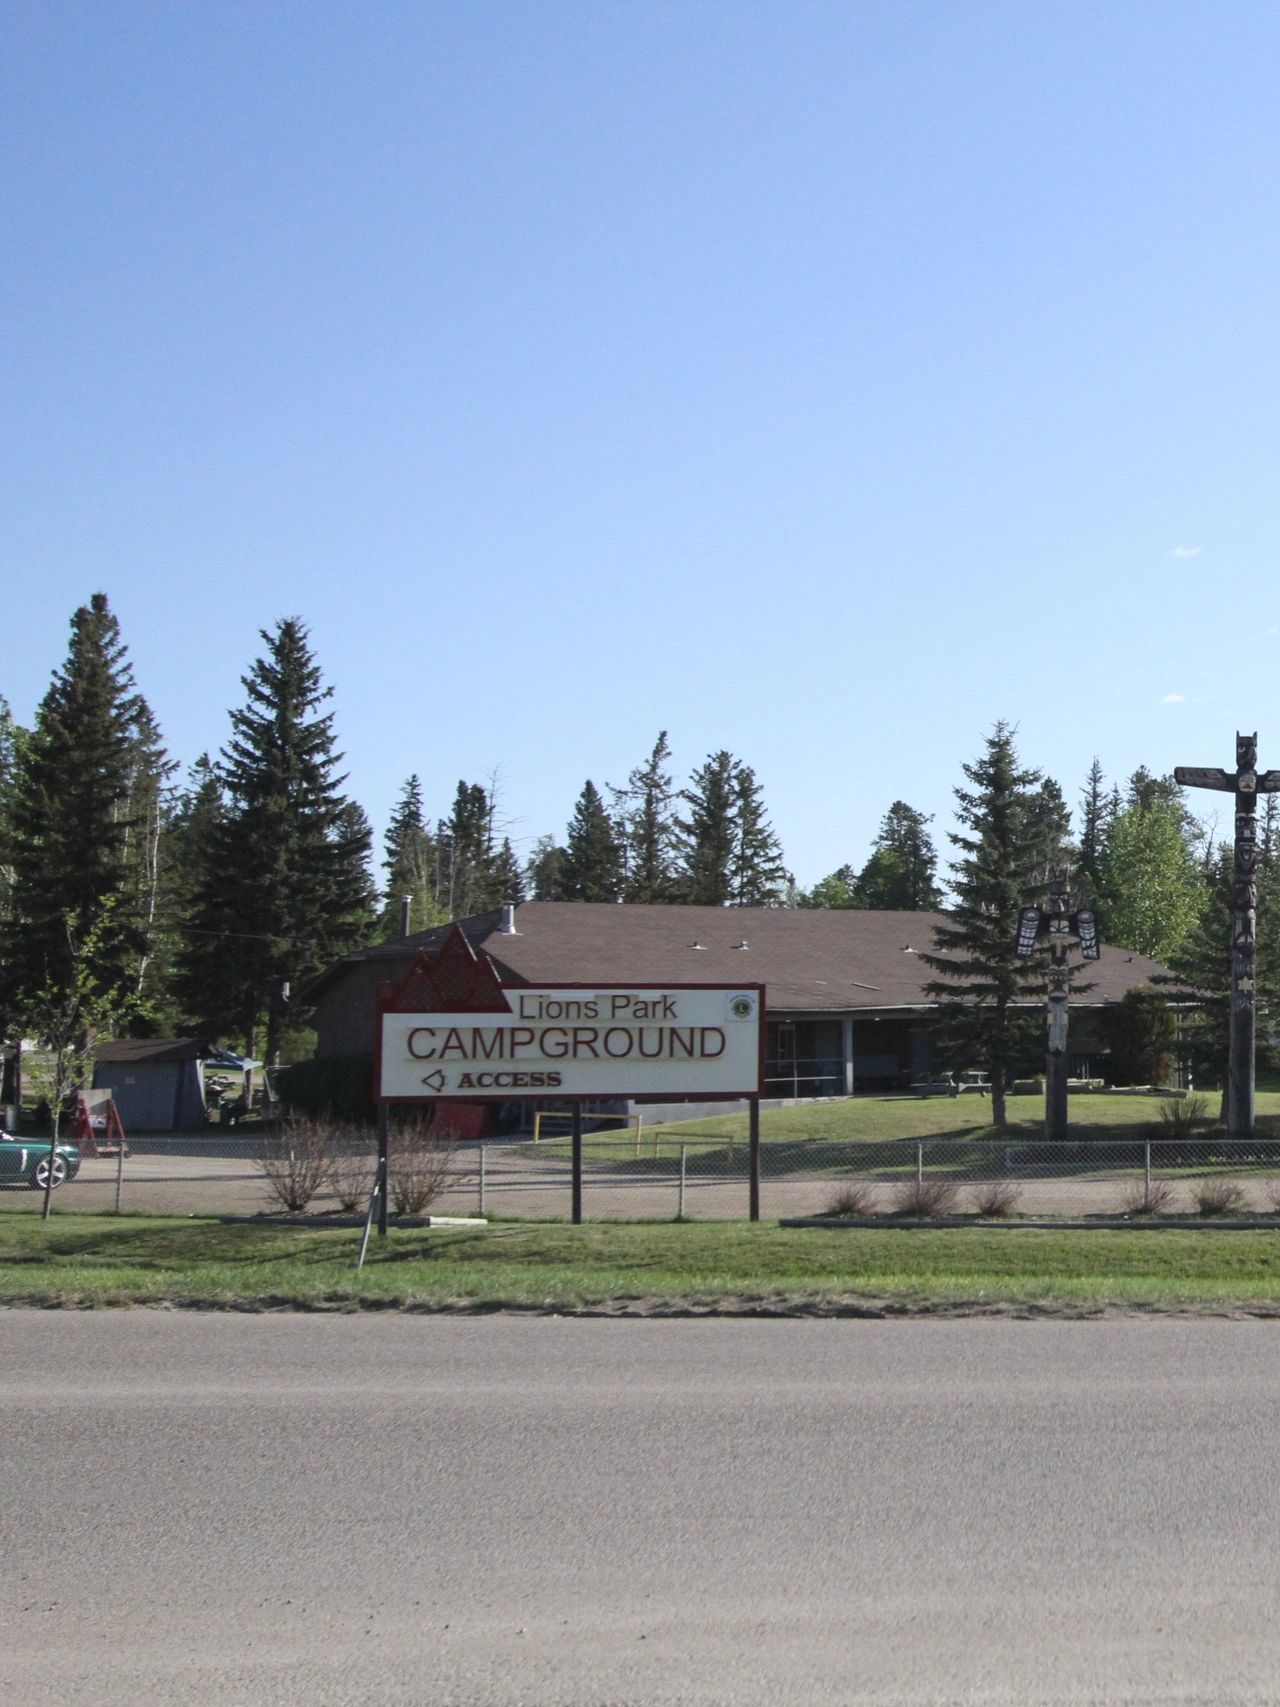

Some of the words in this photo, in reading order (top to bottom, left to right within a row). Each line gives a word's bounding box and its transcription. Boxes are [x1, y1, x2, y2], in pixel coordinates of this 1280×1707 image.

[519, 994, 599, 1020] Lions
[611, 994, 678, 1020] Park
[406, 1026, 727, 1060] CAMPGROUND
[457, 1071, 562, 1088] ACCESS
